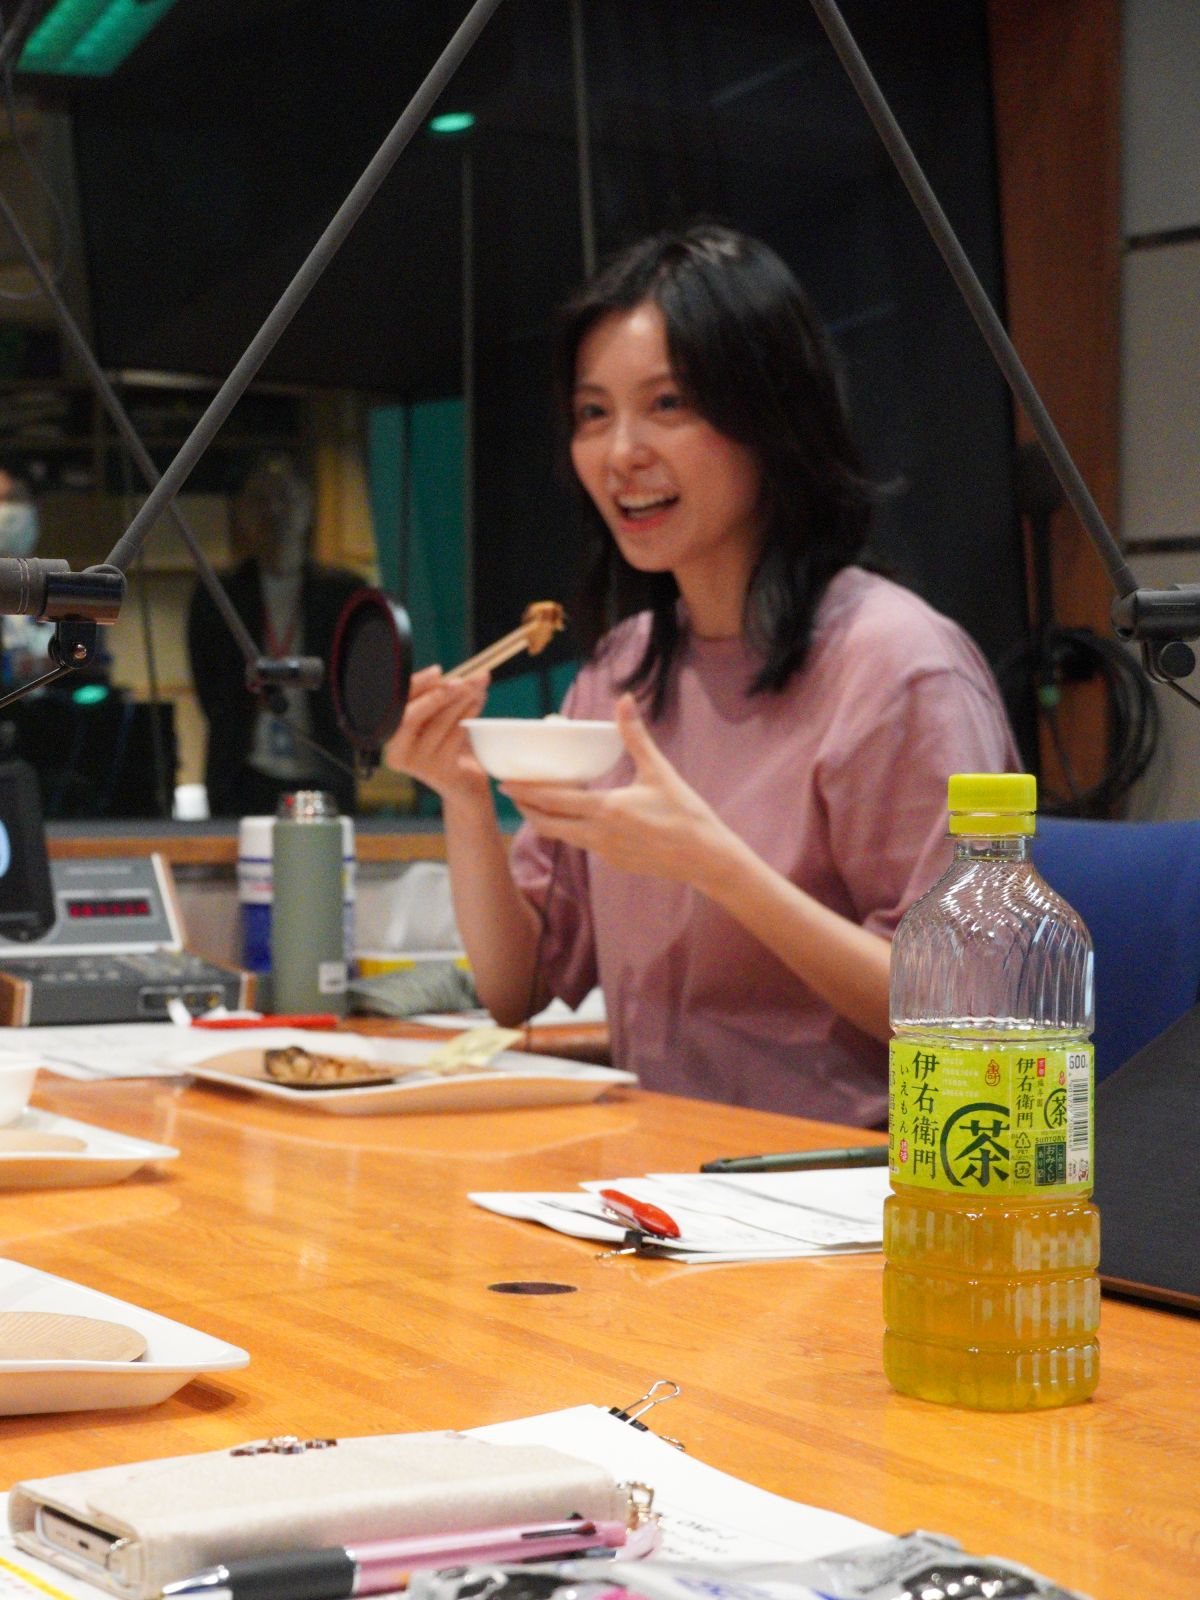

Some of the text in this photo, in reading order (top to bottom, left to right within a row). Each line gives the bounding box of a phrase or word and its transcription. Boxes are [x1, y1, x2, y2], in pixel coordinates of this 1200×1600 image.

[899, 1064, 909, 1134] いえもん
[911, 1050, 940, 1181] 伊右衛門
[1016, 1057, 1036, 1128] 伊右衛門
[1050, 1096, 1067, 1127] 茶
[954, 1119, 1010, 1187] 茶
[1035, 1135, 1066, 1144] SUNTORY
[1045, 1146, 1056, 1182] おみくじ
